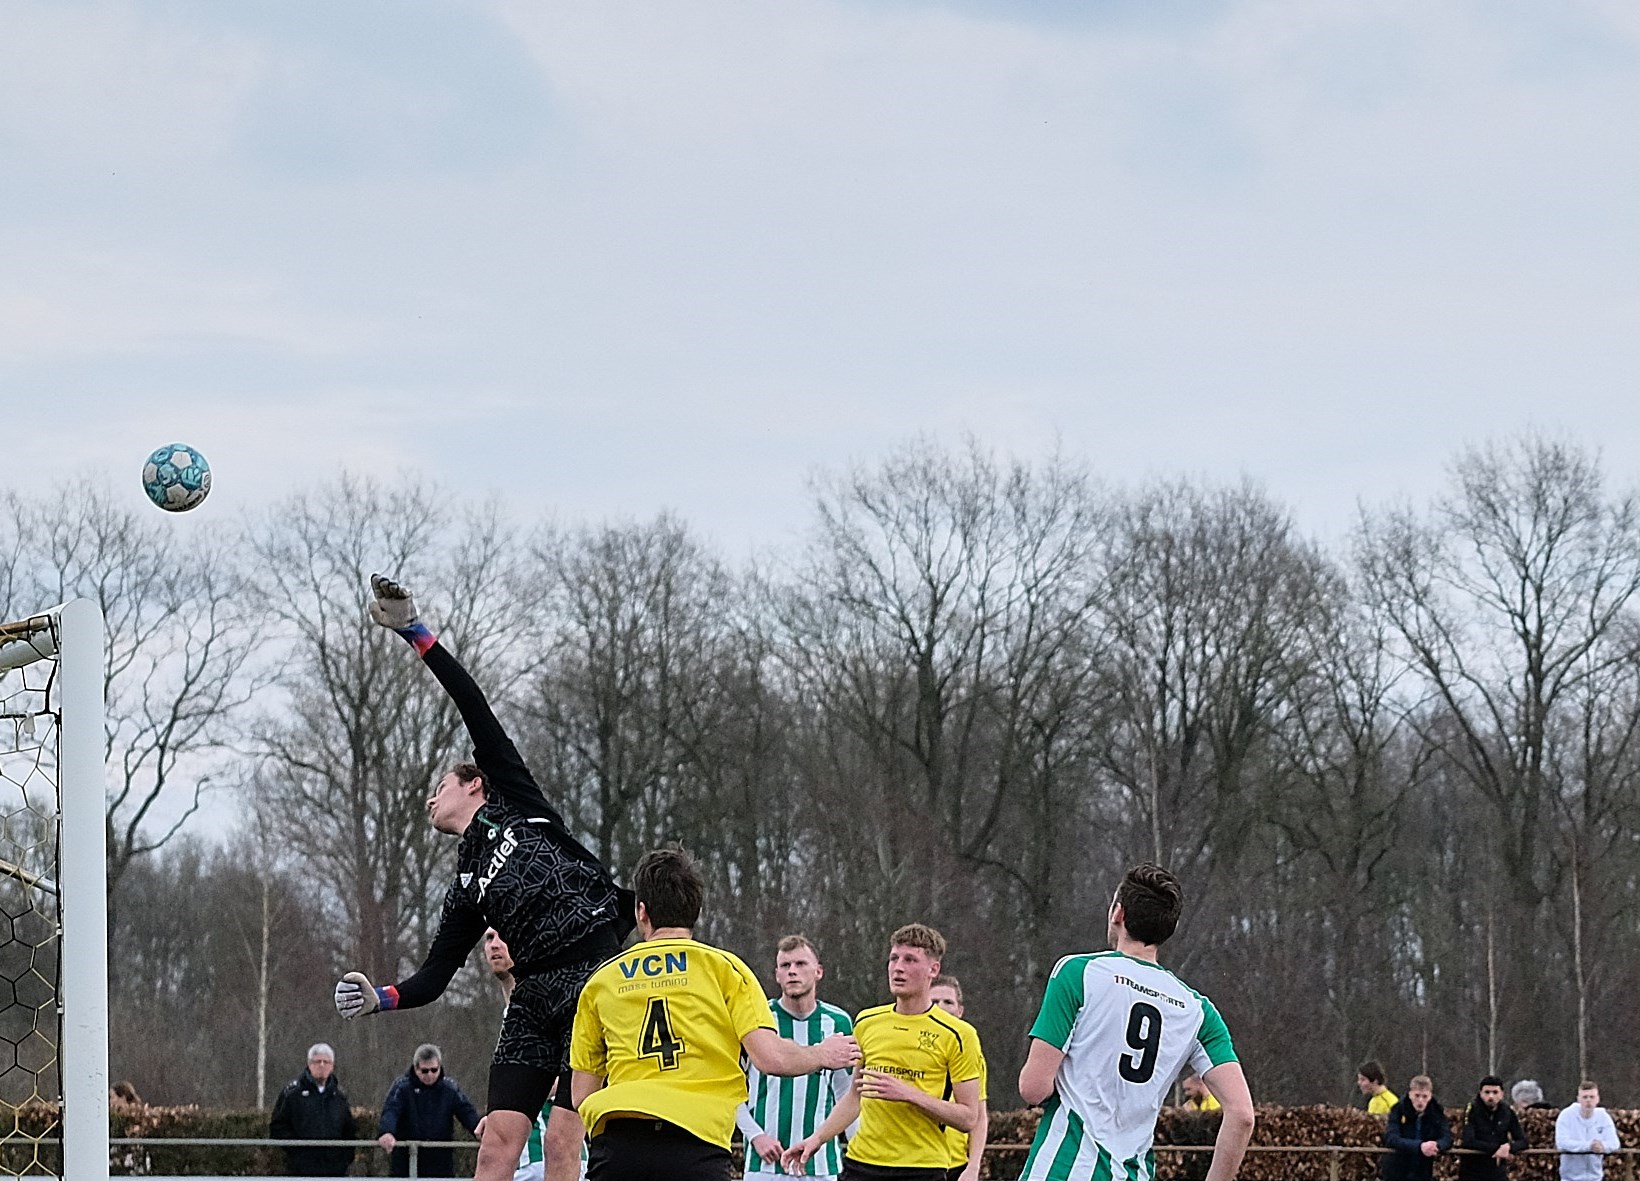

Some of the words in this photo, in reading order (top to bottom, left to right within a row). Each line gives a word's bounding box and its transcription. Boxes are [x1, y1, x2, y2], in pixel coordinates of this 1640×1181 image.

[618, 982, 647, 994] mass
[619, 951, 687, 979] VCN
[637, 995, 685, 1072] 4
[1118, 1002, 1162, 1083] 9
